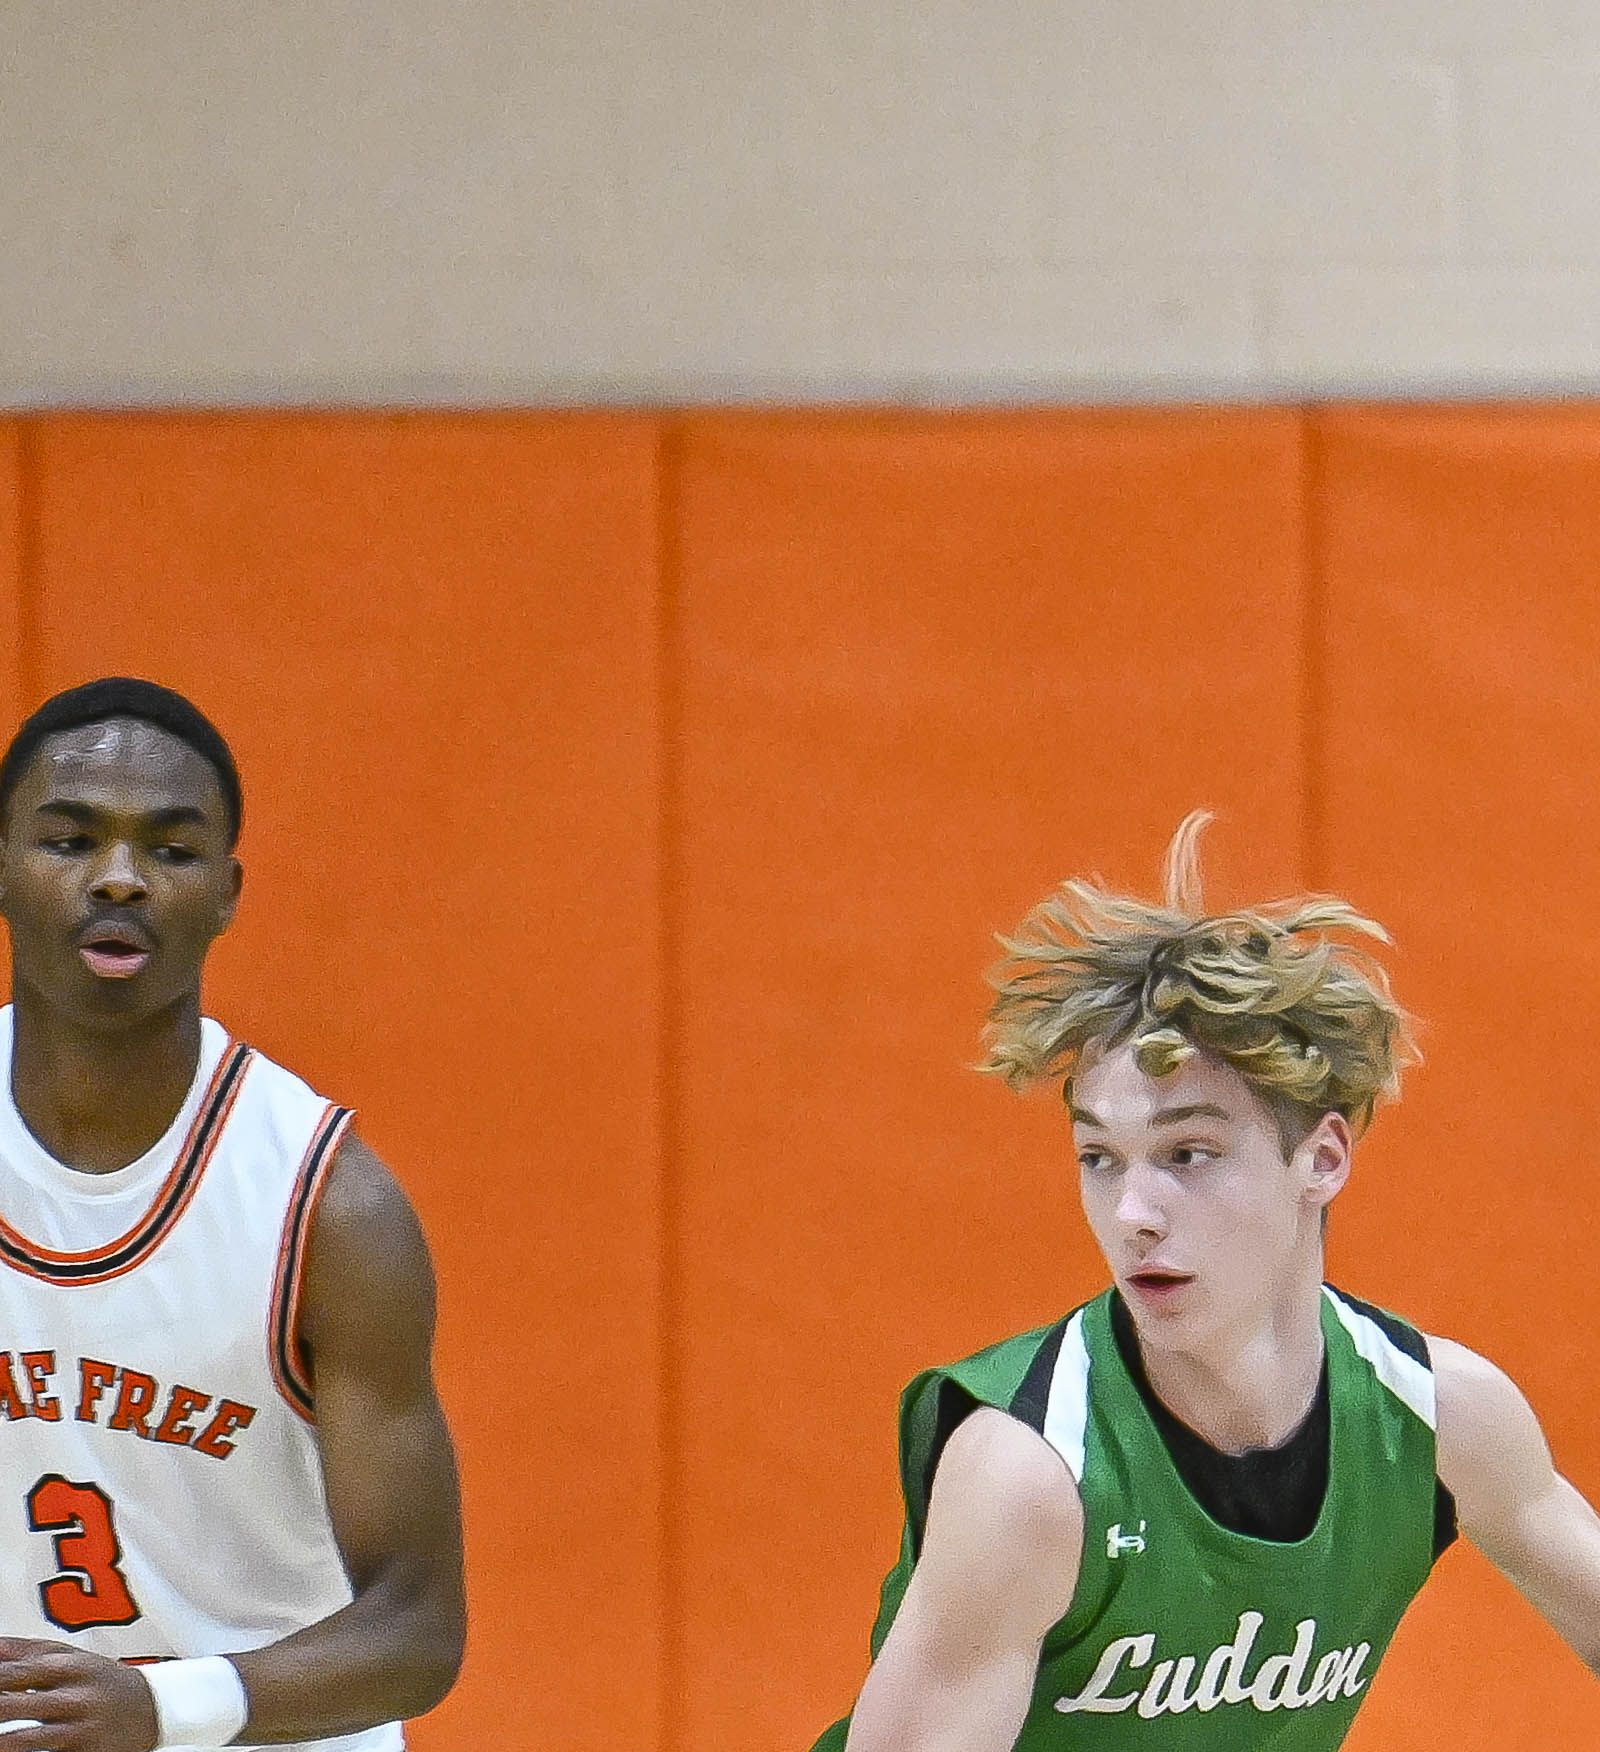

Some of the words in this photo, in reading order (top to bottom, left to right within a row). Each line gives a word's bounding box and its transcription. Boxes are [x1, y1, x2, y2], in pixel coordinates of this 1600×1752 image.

[74, 1356, 259, 1461] FREE
[26, 1472, 142, 1633] 3
[1053, 1610, 1372, 1720] Ludden
